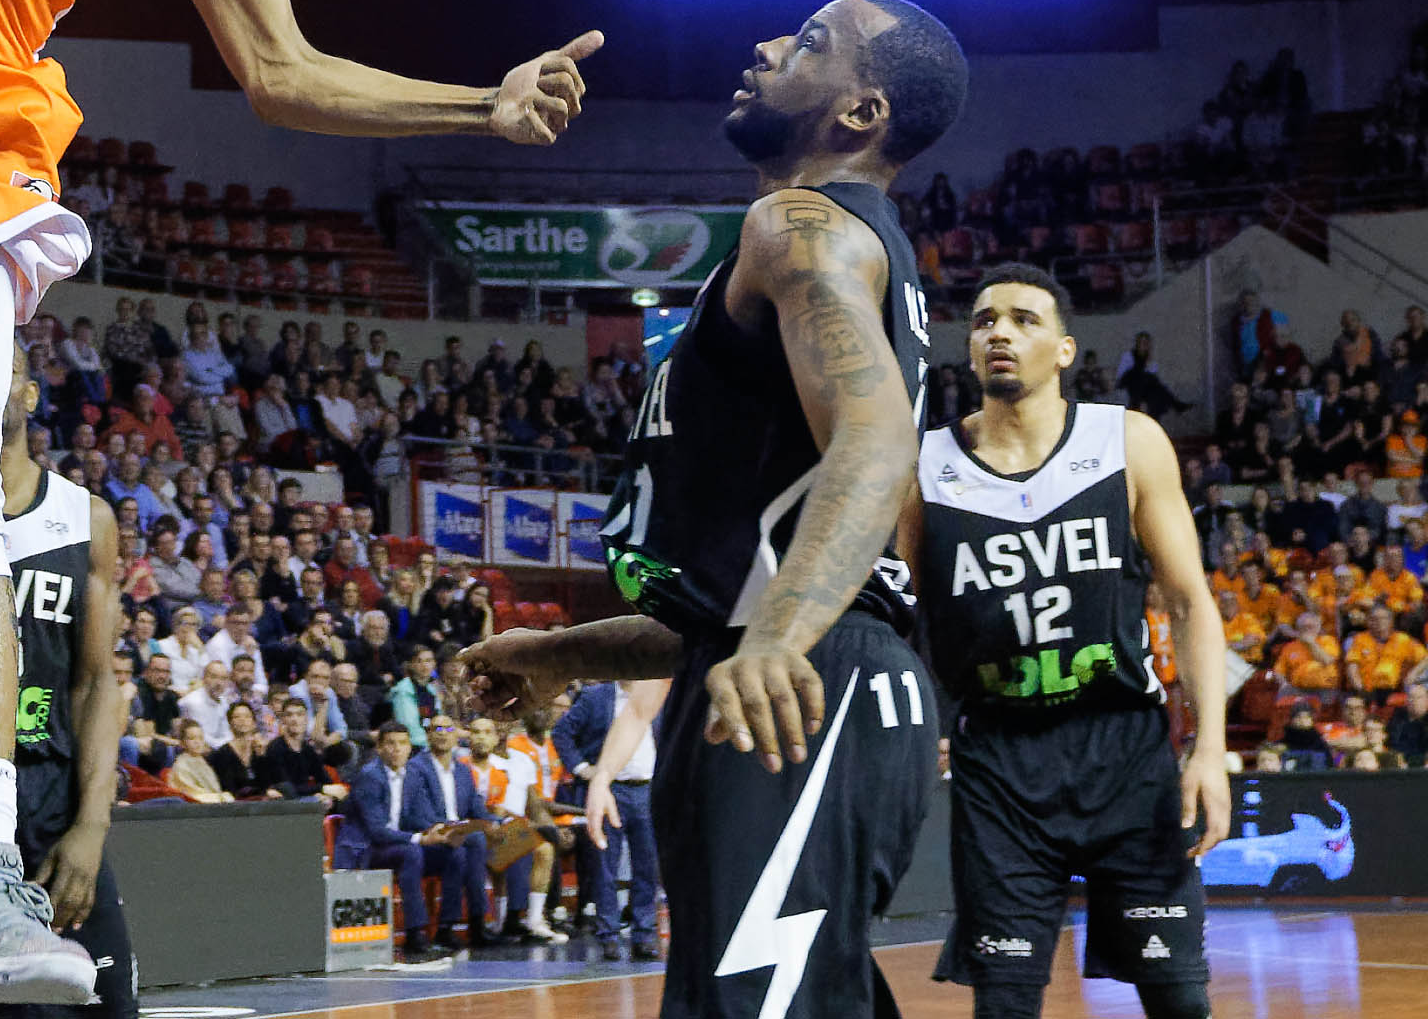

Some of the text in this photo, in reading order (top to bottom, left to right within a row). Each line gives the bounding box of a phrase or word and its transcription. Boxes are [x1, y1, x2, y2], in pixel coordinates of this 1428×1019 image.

[454, 214, 590, 254] Sarthe
[951, 516, 1123, 597] ASVEL
[16, 569, 73, 625] VEL
[1002, 584, 1075, 648] 12
[869, 670, 924, 729] 11
